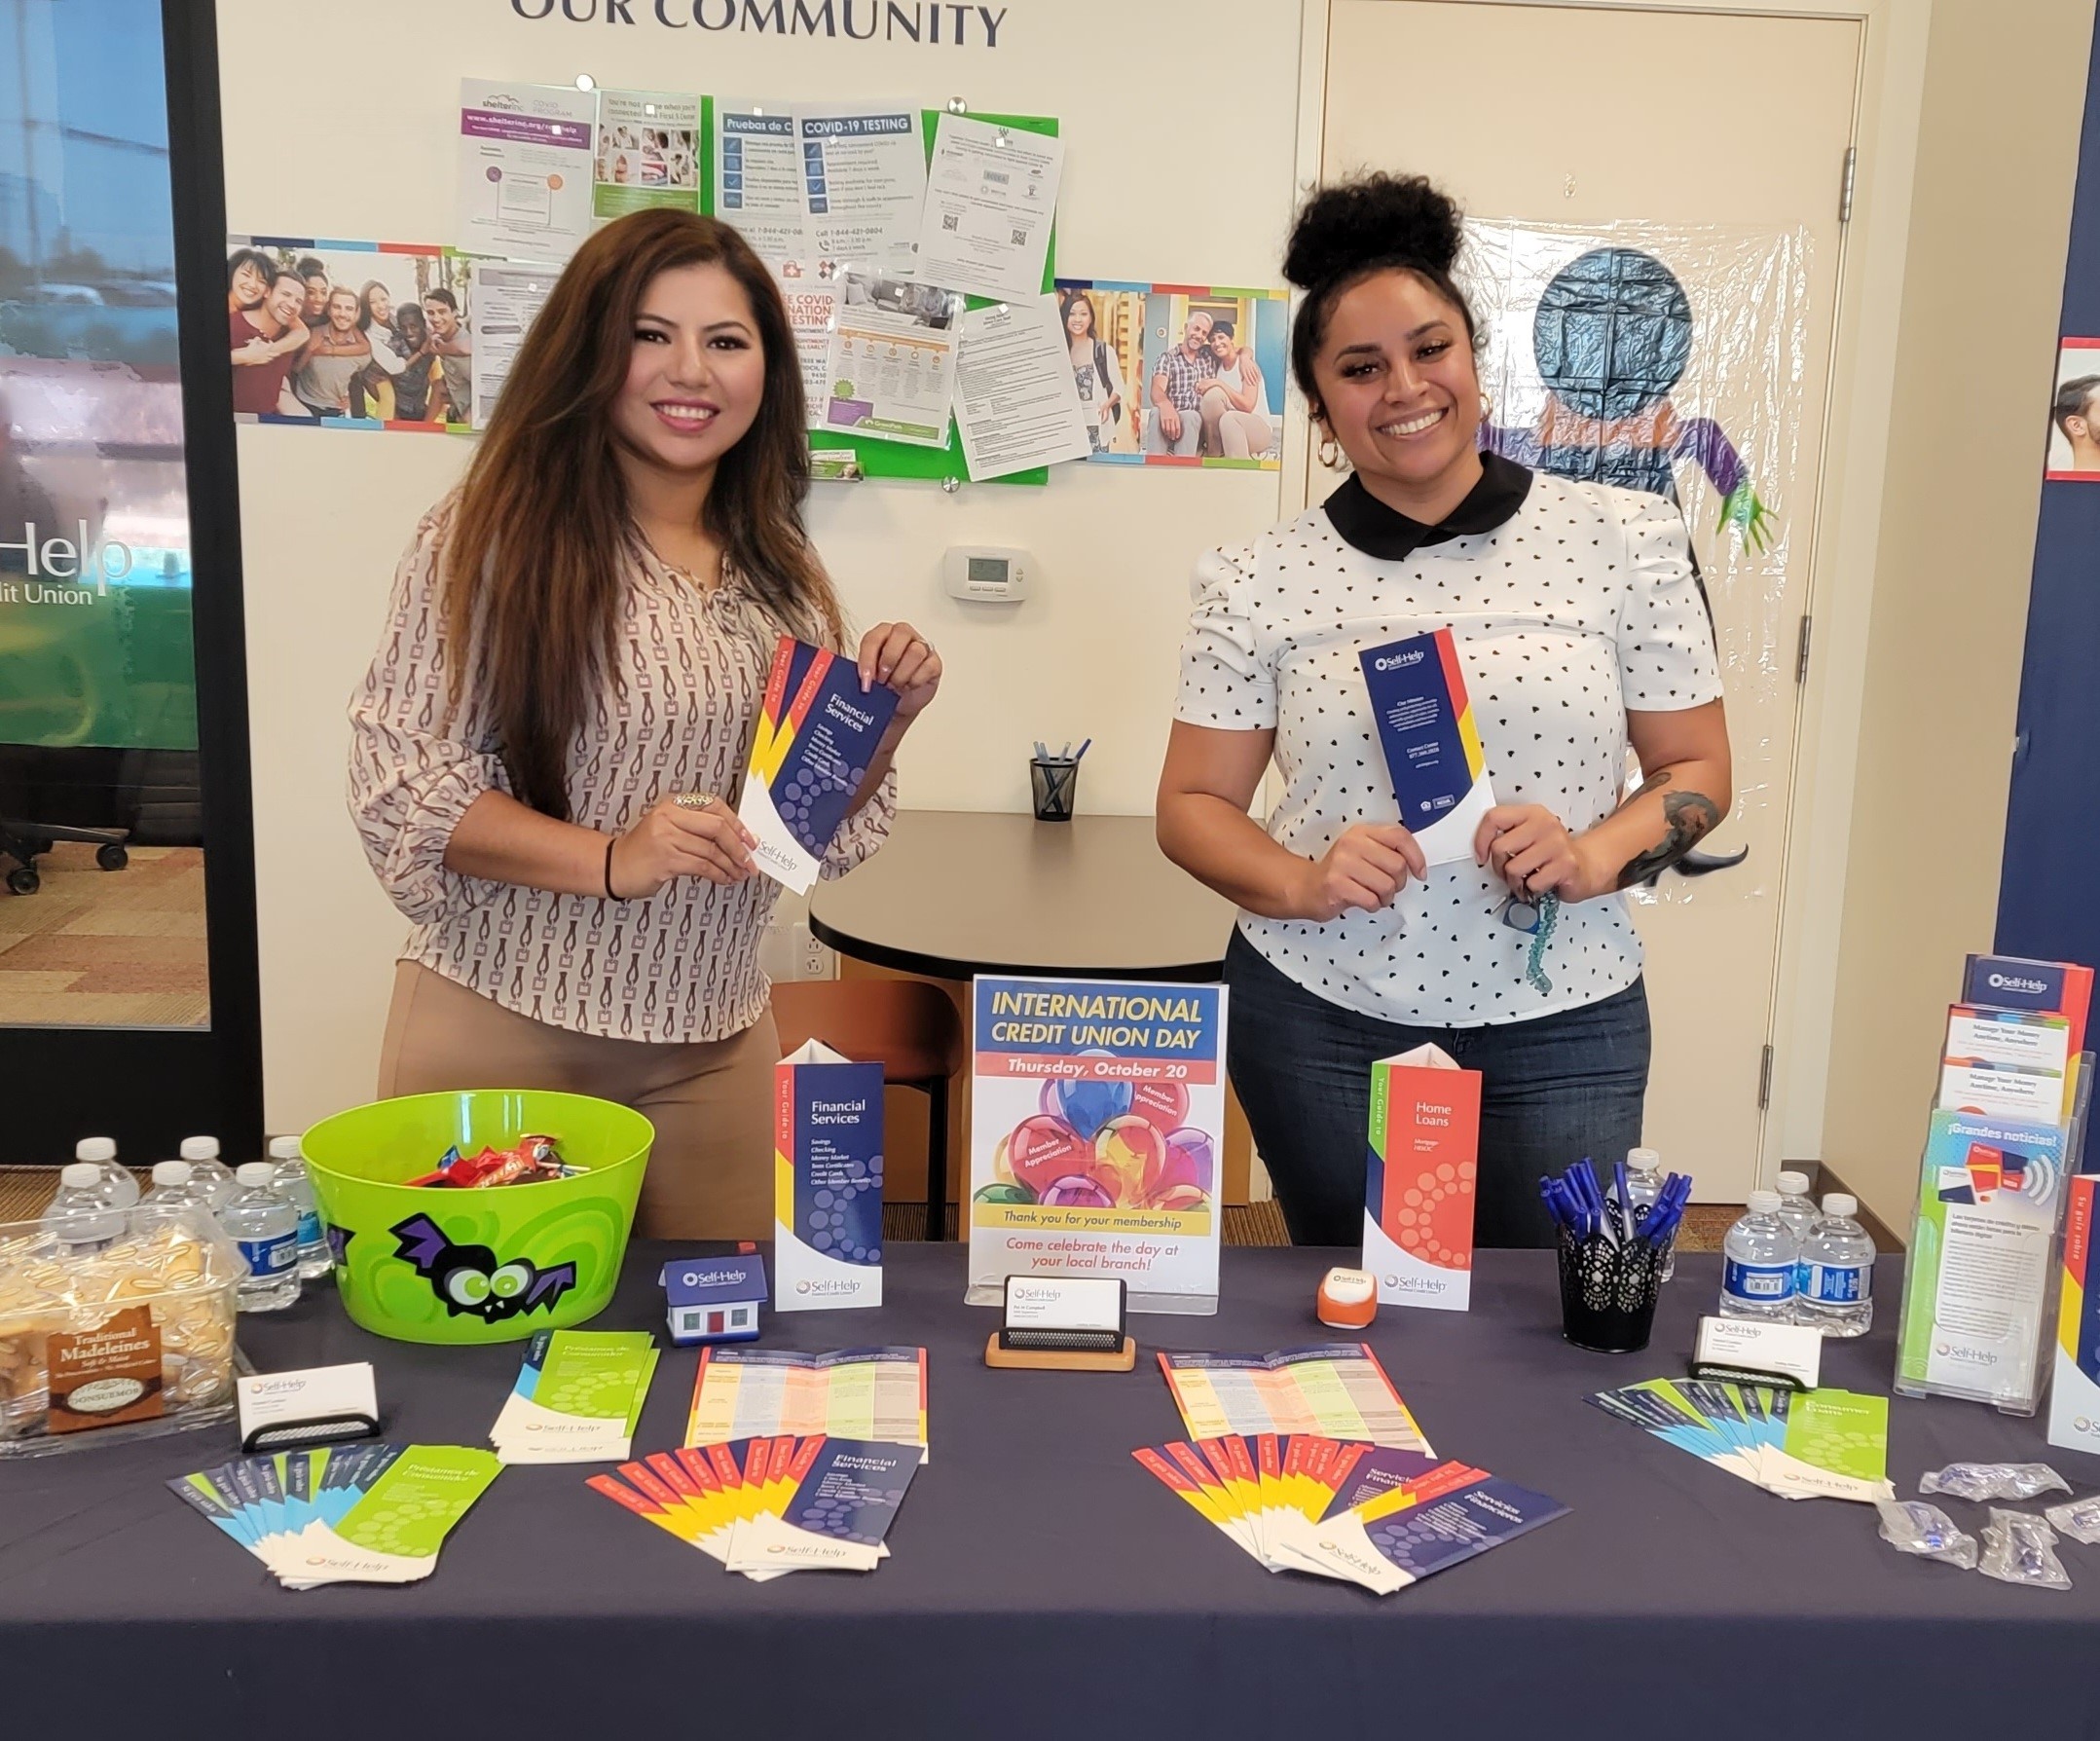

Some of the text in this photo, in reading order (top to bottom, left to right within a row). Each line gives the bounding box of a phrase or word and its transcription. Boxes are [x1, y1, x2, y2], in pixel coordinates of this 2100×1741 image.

[654, 0, 1008, 48] COMMUNITY
[726, 118, 766, 131] Pruebas
[768, 121, 782, 131] de
[804, 118, 908, 135] COVID-19 TESTING
[24, 583, 93, 606] Union
[1386, 649, 1424, 667] Self-Help
[825, 703, 865, 732] Services
[830, 693, 874, 725] Financial
[758, 840, 797, 871] Self-Help
[2002, 977, 2048, 993] Self-Help
[991, 991, 1202, 1022] INTERNATIONAL
[991, 1021, 1202, 1050] CREDIT UNION DAY
[1008, 1057, 1188, 1079] Thursday, October 20
[1142, 1085, 1175, 1104] Member
[811, 1098, 866, 1112] Financial
[1134, 1091, 1178, 1118] ppreciation
[1417, 1102, 1452, 1115] Home
[811, 1113, 861, 1125] Services
[1416, 1114, 1449, 1127] Loans
[781, 1130, 789, 1139] to
[1948, 1123, 2056, 1147] ¡Grandes noticias!
[1028, 1137, 1060, 1156] Member
[1024, 1144, 1072, 1168] Appreciation
[1004, 1210, 1182, 1232] Thank you for your membership
[1006, 1237, 1179, 1259] Come celebrate the day at
[1030, 1254, 1153, 1272] your local branch!
[697, 1270, 747, 1284] Self-Help
[811, 1278, 861, 1293] Self-Help
[1399, 1277, 1446, 1293] Self-Help
[1025, 1288, 1061, 1301] Self-Help
[75, 1327, 138, 1346] Traditional
[1725, 1323, 1761, 1338] Self-Help
[60, 1340, 151, 1362] Madeleines
[1951, 1346, 1998, 1365] Self-Help
[264, 1379, 307, 1391] Self-Help
[831, 1461, 887, 1472] Services
[835, 1454, 898, 1467] Financial
[1802, 1476, 1859, 1491] Self-Help
[786, 1545, 848, 1558] Self-Help
